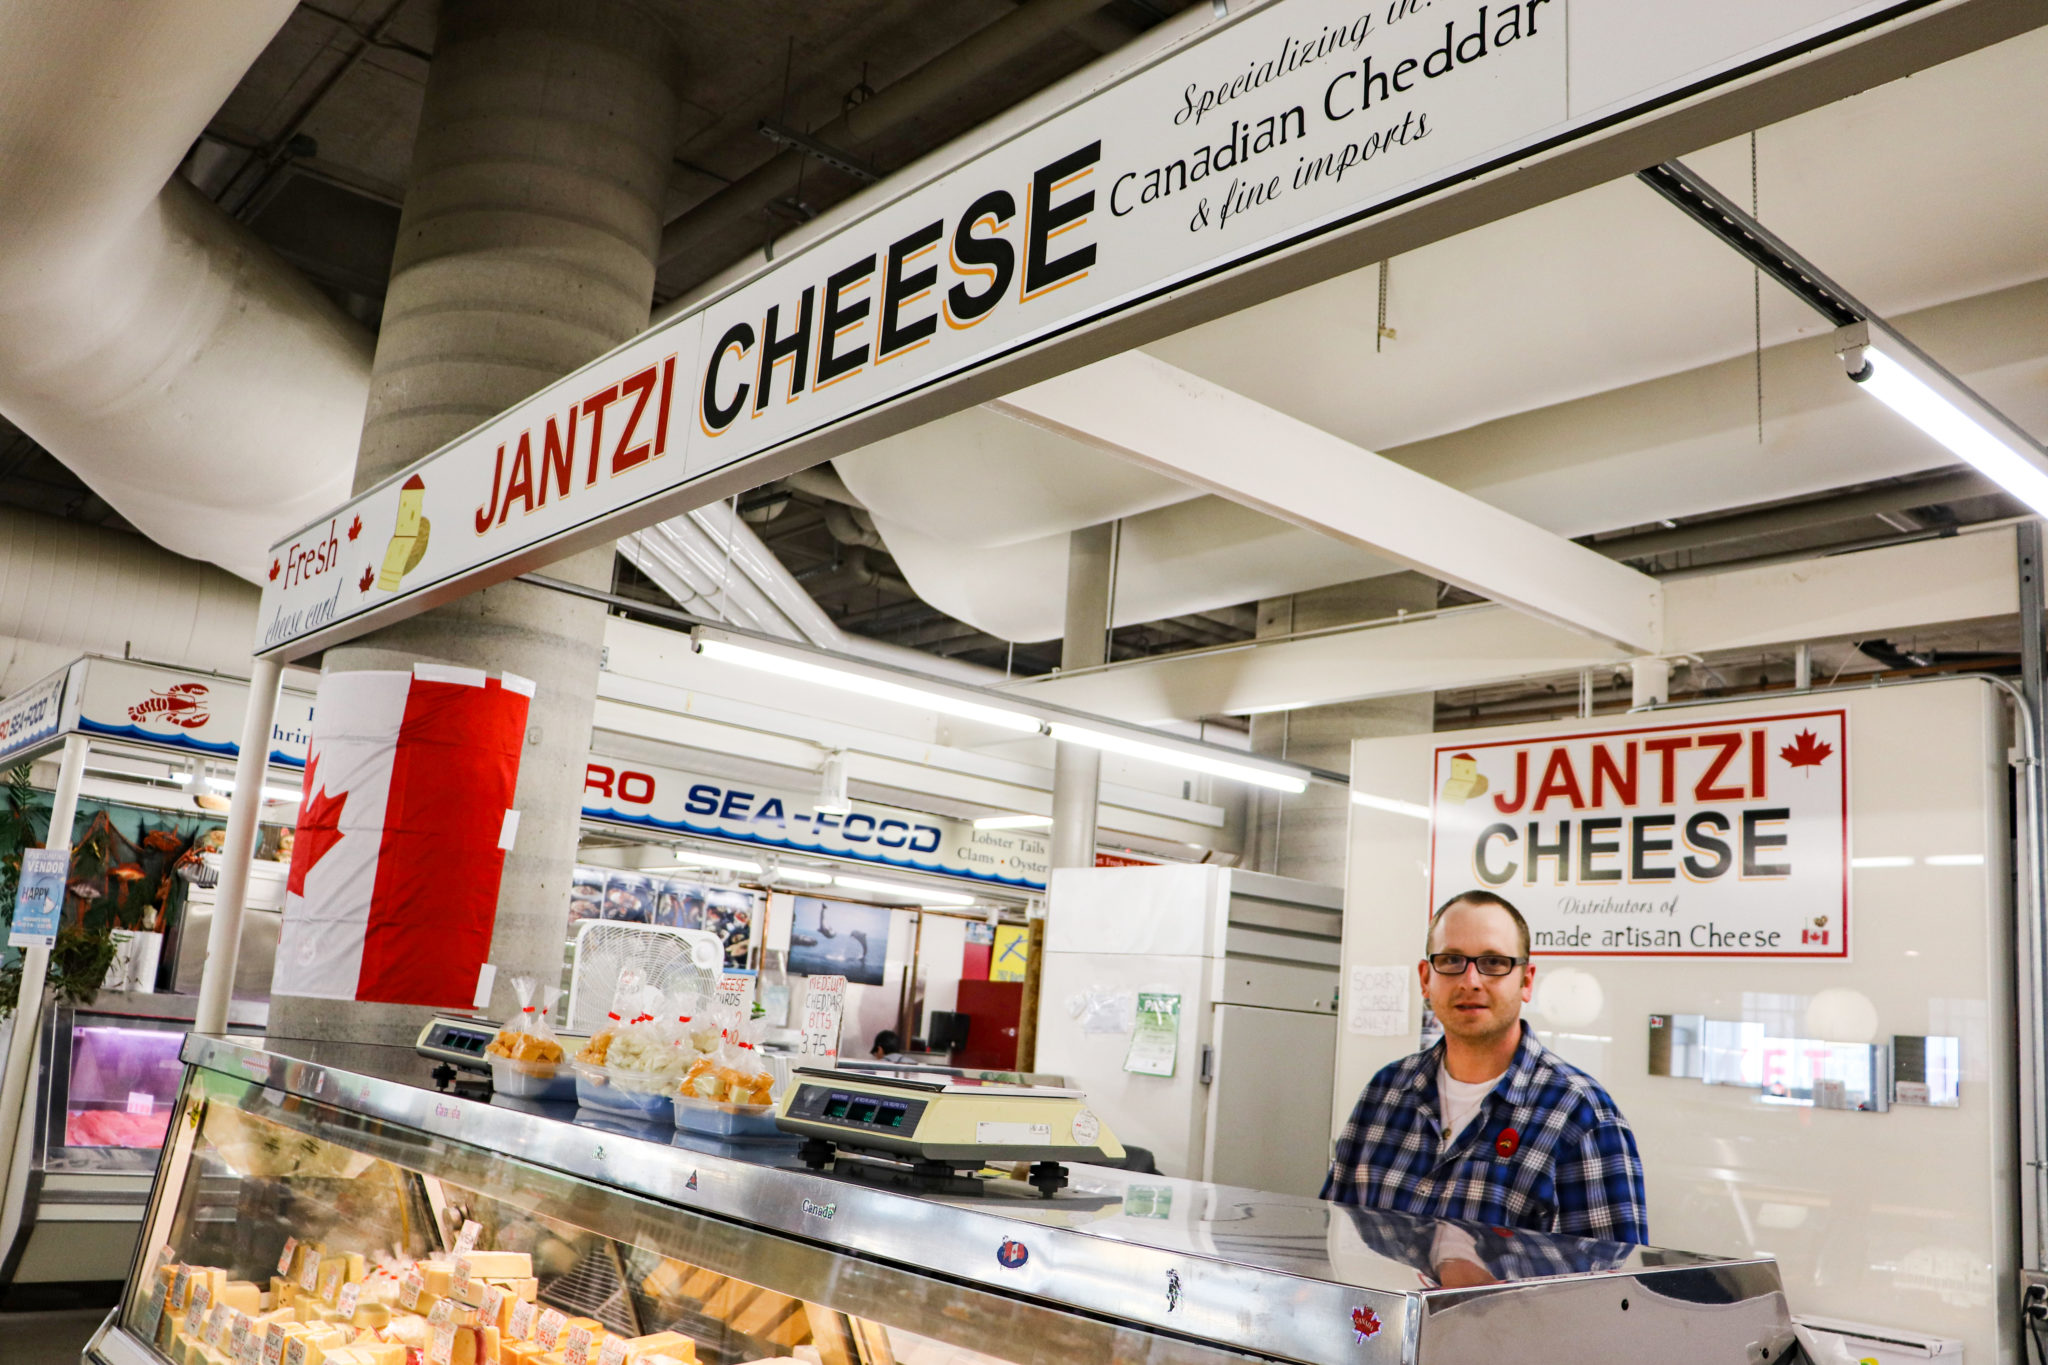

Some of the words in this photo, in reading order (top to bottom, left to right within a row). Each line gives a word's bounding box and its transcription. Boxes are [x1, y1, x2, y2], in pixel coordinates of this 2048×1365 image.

[1173, 13, 1375, 126] Specializing
[1110, 104, 1306, 218] Canadian
[1324, 0, 1550, 122] Cheddar
[1190, 197, 1211, 233] &
[1220, 171, 1283, 230] fine
[1292, 110, 1432, 190] imports
[474, 353, 678, 537] JANTZI
[699, 139, 1101, 437] CHEESE
[283, 519, 338, 590] Fresh
[264, 604, 303, 645] cheese
[304, 576, 343, 630] curd
[1493, 727, 1768, 815] JANTZI
[584, 763, 656, 805] RO
[684, 784, 942, 853] SEA-FOOD
[957, 847, 994, 864] Clams
[971, 830, 1014, 849] Lobster
[1019, 839, 1045, 854] Tails
[1472, 807, 1791, 888] CHEESE
[27, 861, 65, 874] VENDOR
[22, 886, 50, 901] HAPPY
[1558, 896, 1653, 915] Distributors
[1660, 895, 1679, 916] of
[1535, 925, 1592, 947] made
[1602, 926, 1682, 948] artisan
[1690, 922, 1782, 948] Cheese
[805, 993, 843, 1012] CHEDDAR
[809, 976, 845, 992] MEDIUM
[809, 1011, 832, 1030] BITS
